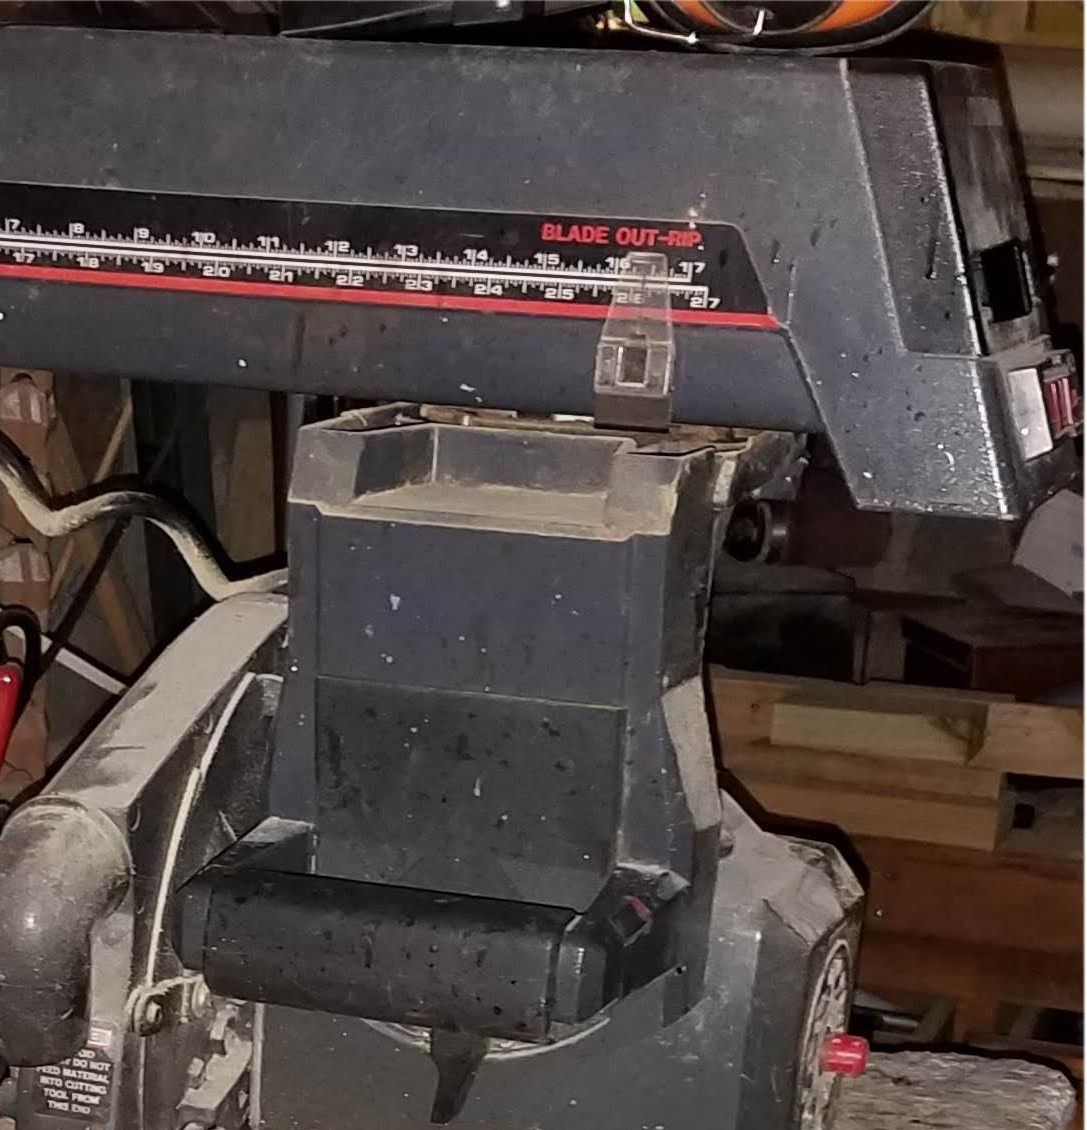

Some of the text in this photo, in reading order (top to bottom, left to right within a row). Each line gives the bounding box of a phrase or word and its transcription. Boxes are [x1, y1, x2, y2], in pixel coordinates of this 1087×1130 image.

[540, 222, 702, 248] BLADE OUT-RIP
[9, 219, 21, 230] 7
[73, 223, 85, 234] 8
[138, 228, 150, 239] 9
[191, 231, 216, 244] 10
[257, 236, 280, 248] 11
[324, 239, 351, 252] 12
[393, 243, 419, 256] 13
[463, 248, 489, 261] 14
[533, 252, 560, 265] 15
[605, 256, 631, 269] 16
[678, 261, 706, 273] 17
[13, 251, 36, 264] 17
[76, 255, 99, 269] 18
[141, 260, 165, 274] 19
[202, 265, 231, 278] 20
[268, 269, 294, 283] 21
[335, 274, 365, 287] 22
[404, 278, 433, 292] 23
[474, 282, 503, 296] 24
[544, 287, 575, 300] 25
[689, 296, 721, 309] 27
[72, 1058, 89, 1068] DO
[89, 1061, 112, 1071] NOT
[39, 1075, 108, 1095] INTO CUTTING
[62, 1067, 110, 1084] MATERIAL
[43, 1087, 102, 1105] TOOL FROM
[47, 1099, 91, 1115] THIS END
